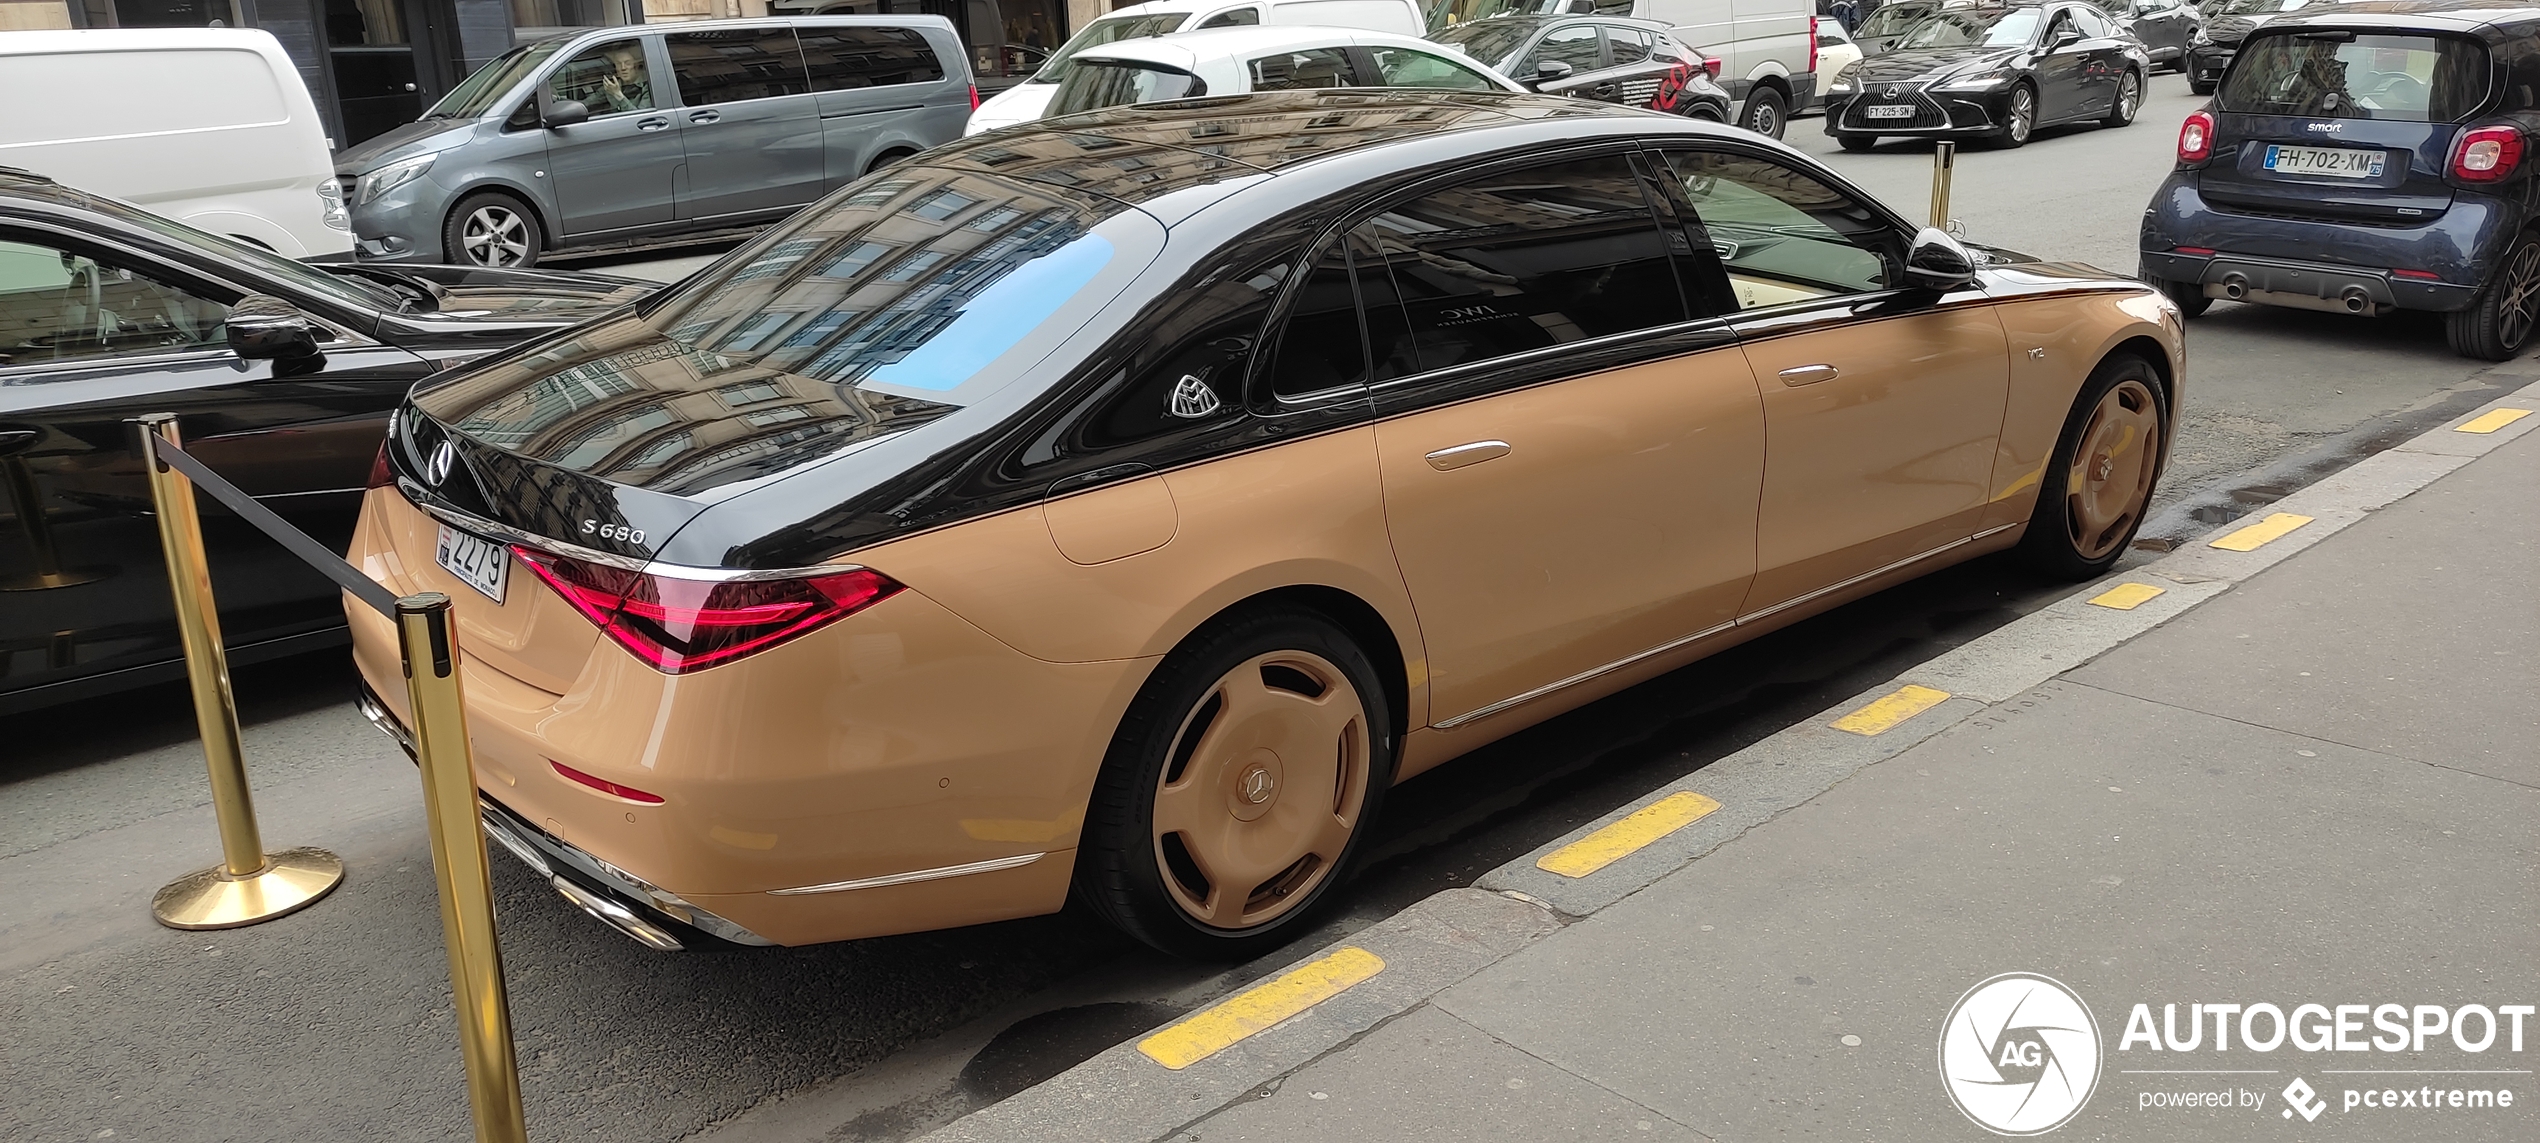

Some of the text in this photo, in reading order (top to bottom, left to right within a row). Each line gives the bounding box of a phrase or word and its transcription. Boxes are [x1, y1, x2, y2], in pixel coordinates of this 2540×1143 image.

[1870, 106, 1910, 117] FY-225-SN
[2307, 123, 2342, 133] smart
[2276, 149, 2370, 171] FH-702-XM
[2371, 164, 2381, 174] 75
[581, 518, 646, 545] S 680
[453, 532, 501, 586] 2279
